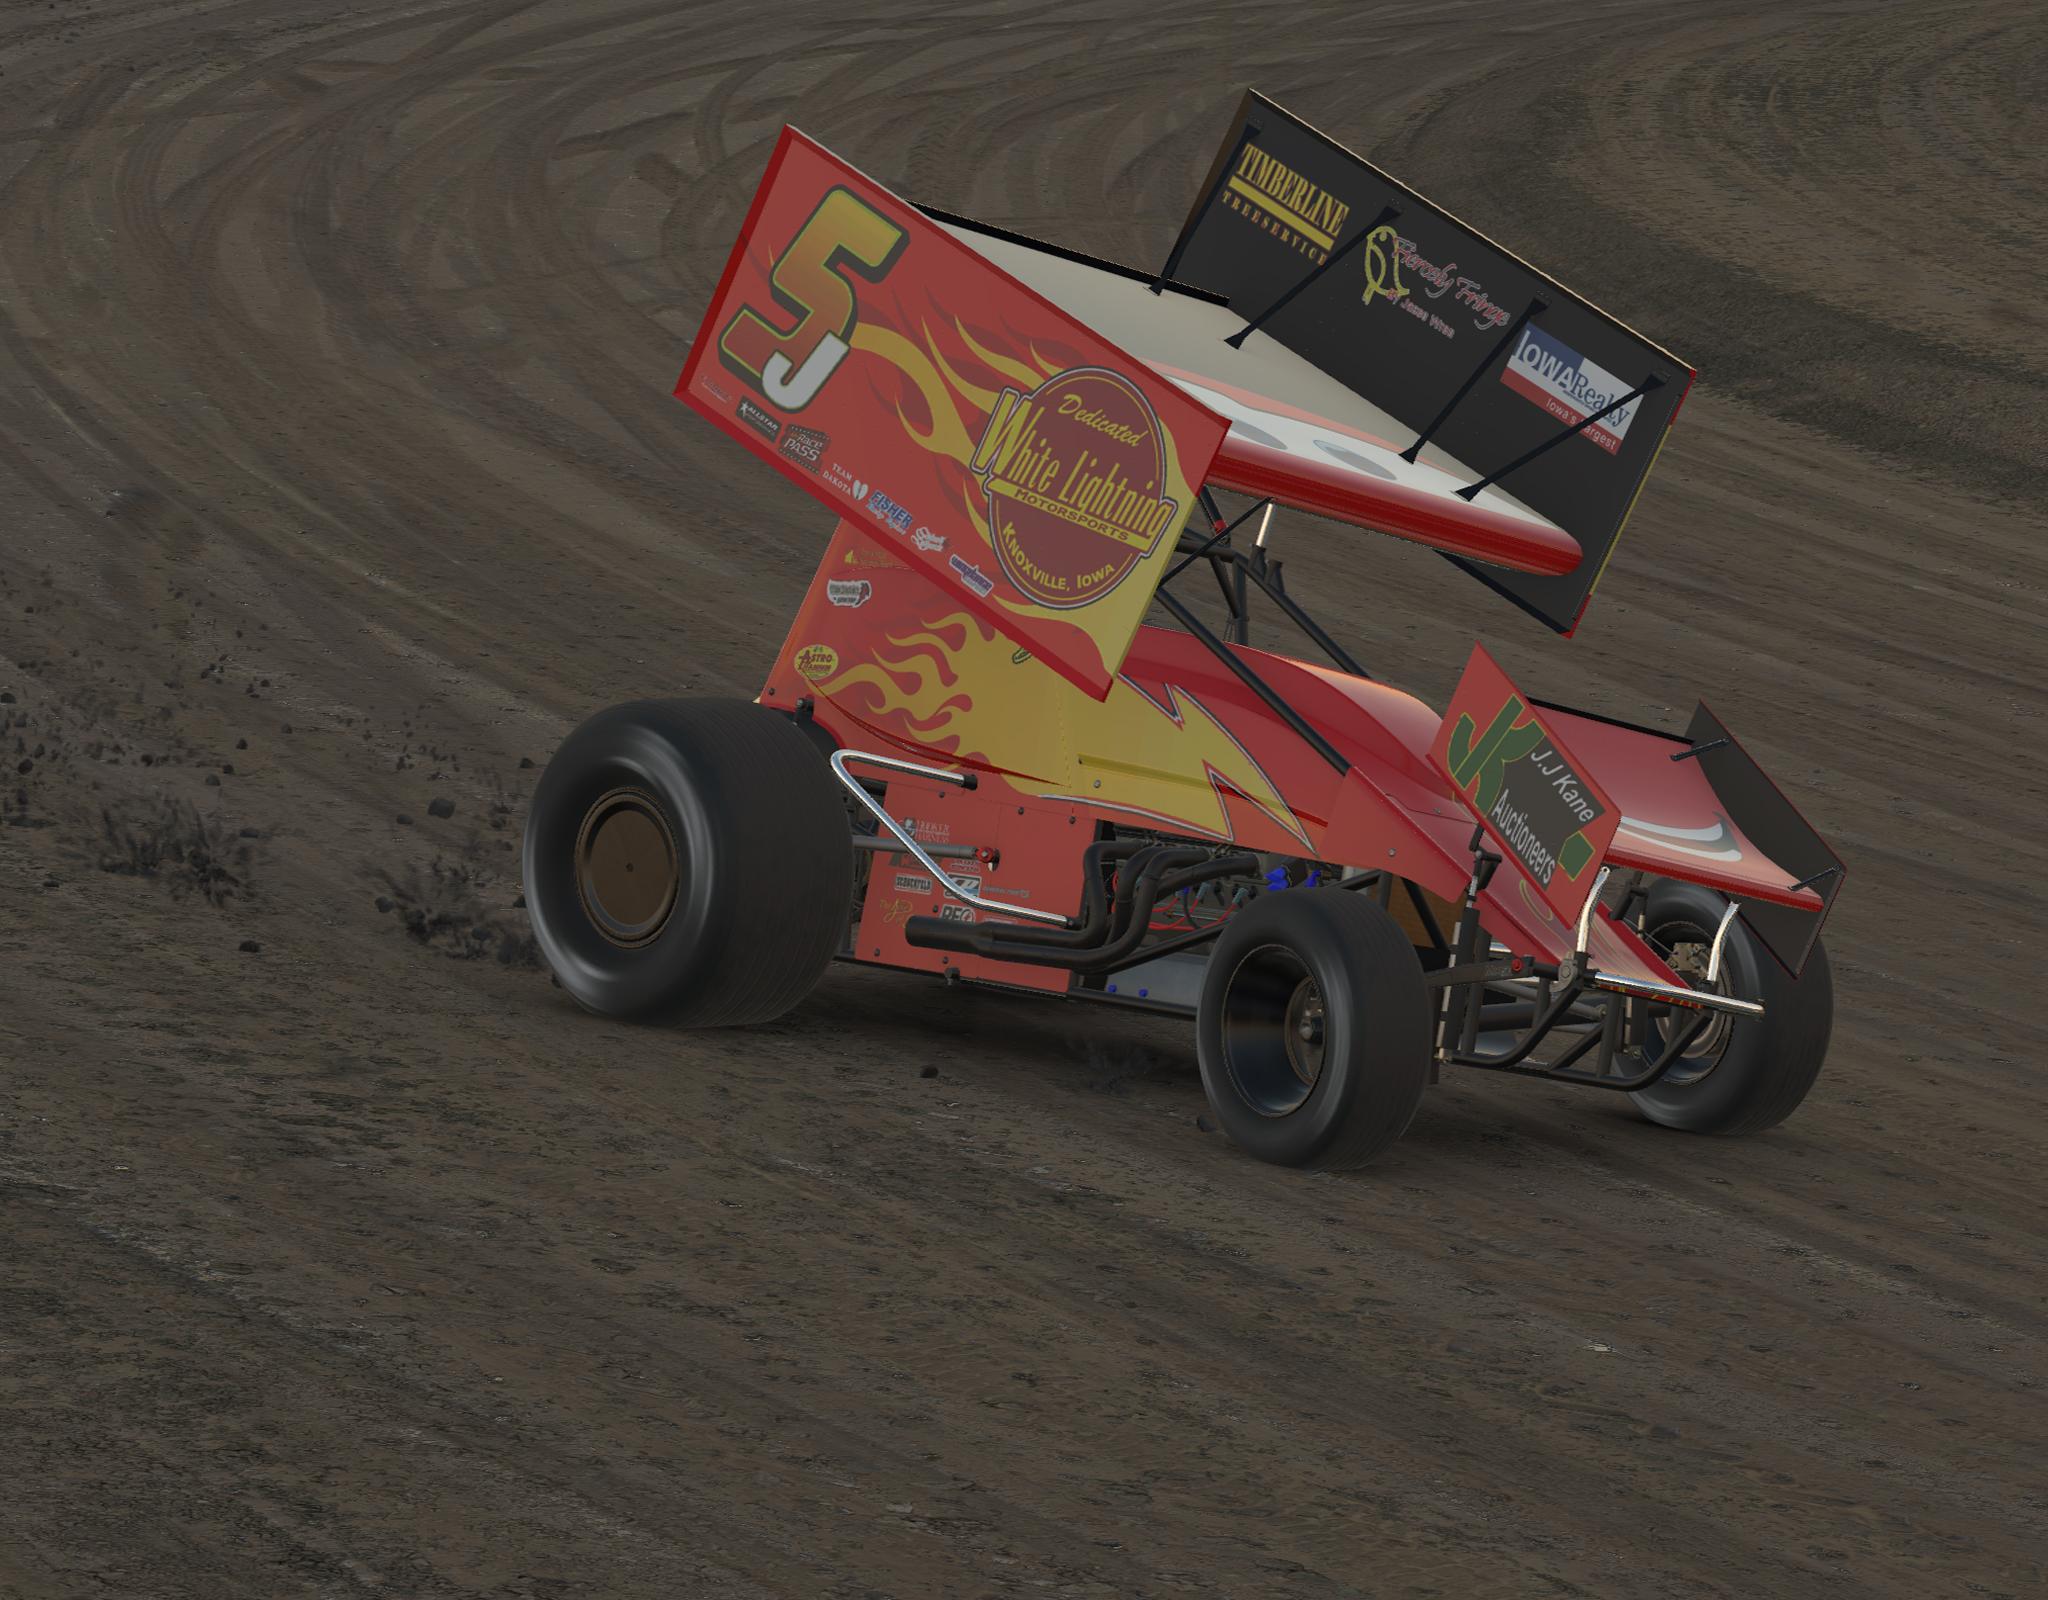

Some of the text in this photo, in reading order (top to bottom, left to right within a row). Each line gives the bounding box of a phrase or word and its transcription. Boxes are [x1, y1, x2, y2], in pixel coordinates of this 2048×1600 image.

[1236, 143, 1350, 238] TIMBERLINE
[1455, 276, 1511, 331] Fringe
[1057, 393, 1149, 448] Dedicated
[1545, 398, 1577, 425] Iowa's
[1580, 418, 1617, 451] argest
[783, 437, 821, 462] PASS
[831, 463, 853, 482] TEAM
[973, 392, 1174, 541] White Lightning
[821, 470, 851, 496] DAKOTA
[870, 490, 912, 529] FISHER
[1013, 488, 1130, 541] MOTORSPORTS
[1002, 521, 1071, 592] KNOXVILLE,
[1076, 563, 1116, 589] IOWA
[1551, 774, 1595, 823] Kane
[1491, 788, 1556, 884] Auctioneers
